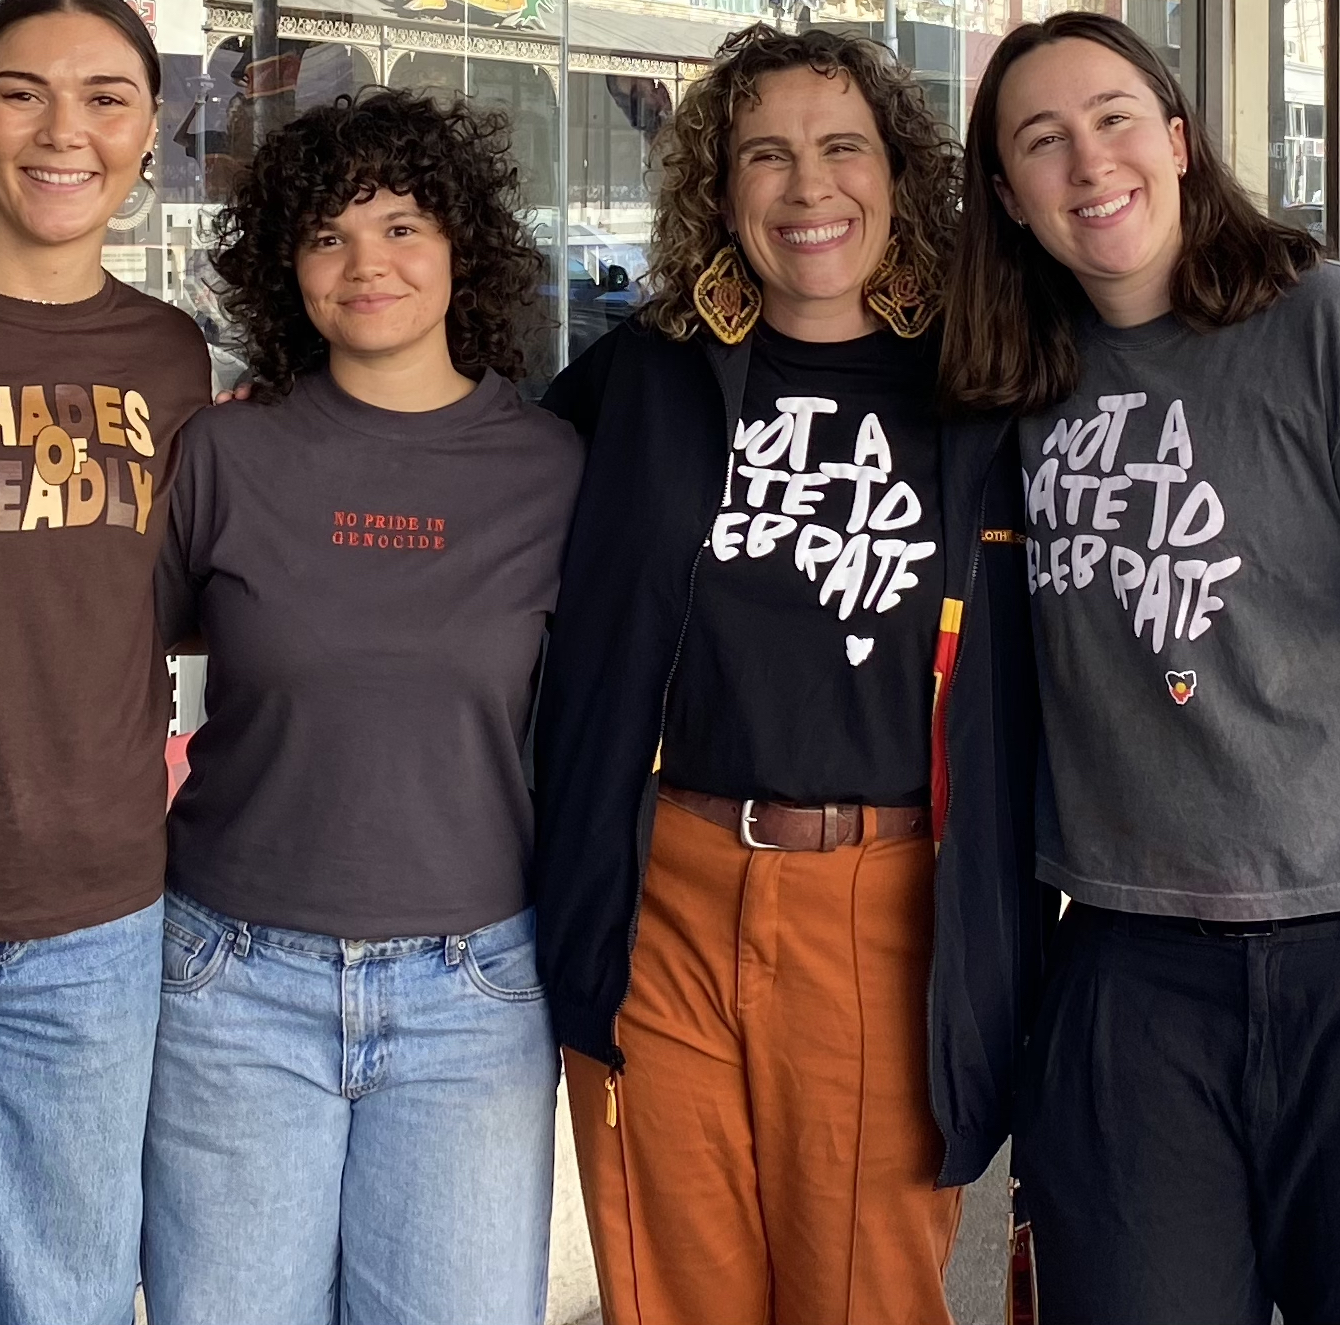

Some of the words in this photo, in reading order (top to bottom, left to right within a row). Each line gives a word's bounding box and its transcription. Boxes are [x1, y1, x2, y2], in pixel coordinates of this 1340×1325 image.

[35, 424, 89, 486] OF
[854, 412, 893, 474] A
[1042, 391, 1148, 473] NOT
[1157, 399, 1193, 470] A
[333, 510, 358, 528] NO
[364, 513, 420, 531] PRIDE
[426, 517, 446, 532] IN
[819, 461, 923, 534] TO
[1022, 457, 1133, 531] ATE
[1124, 462, 1225, 551] TO
[332, 531, 446, 550] GENOCIDE
[703, 511, 937, 622] EBRATE
[1025, 534, 1242, 655] ELEBRATE
